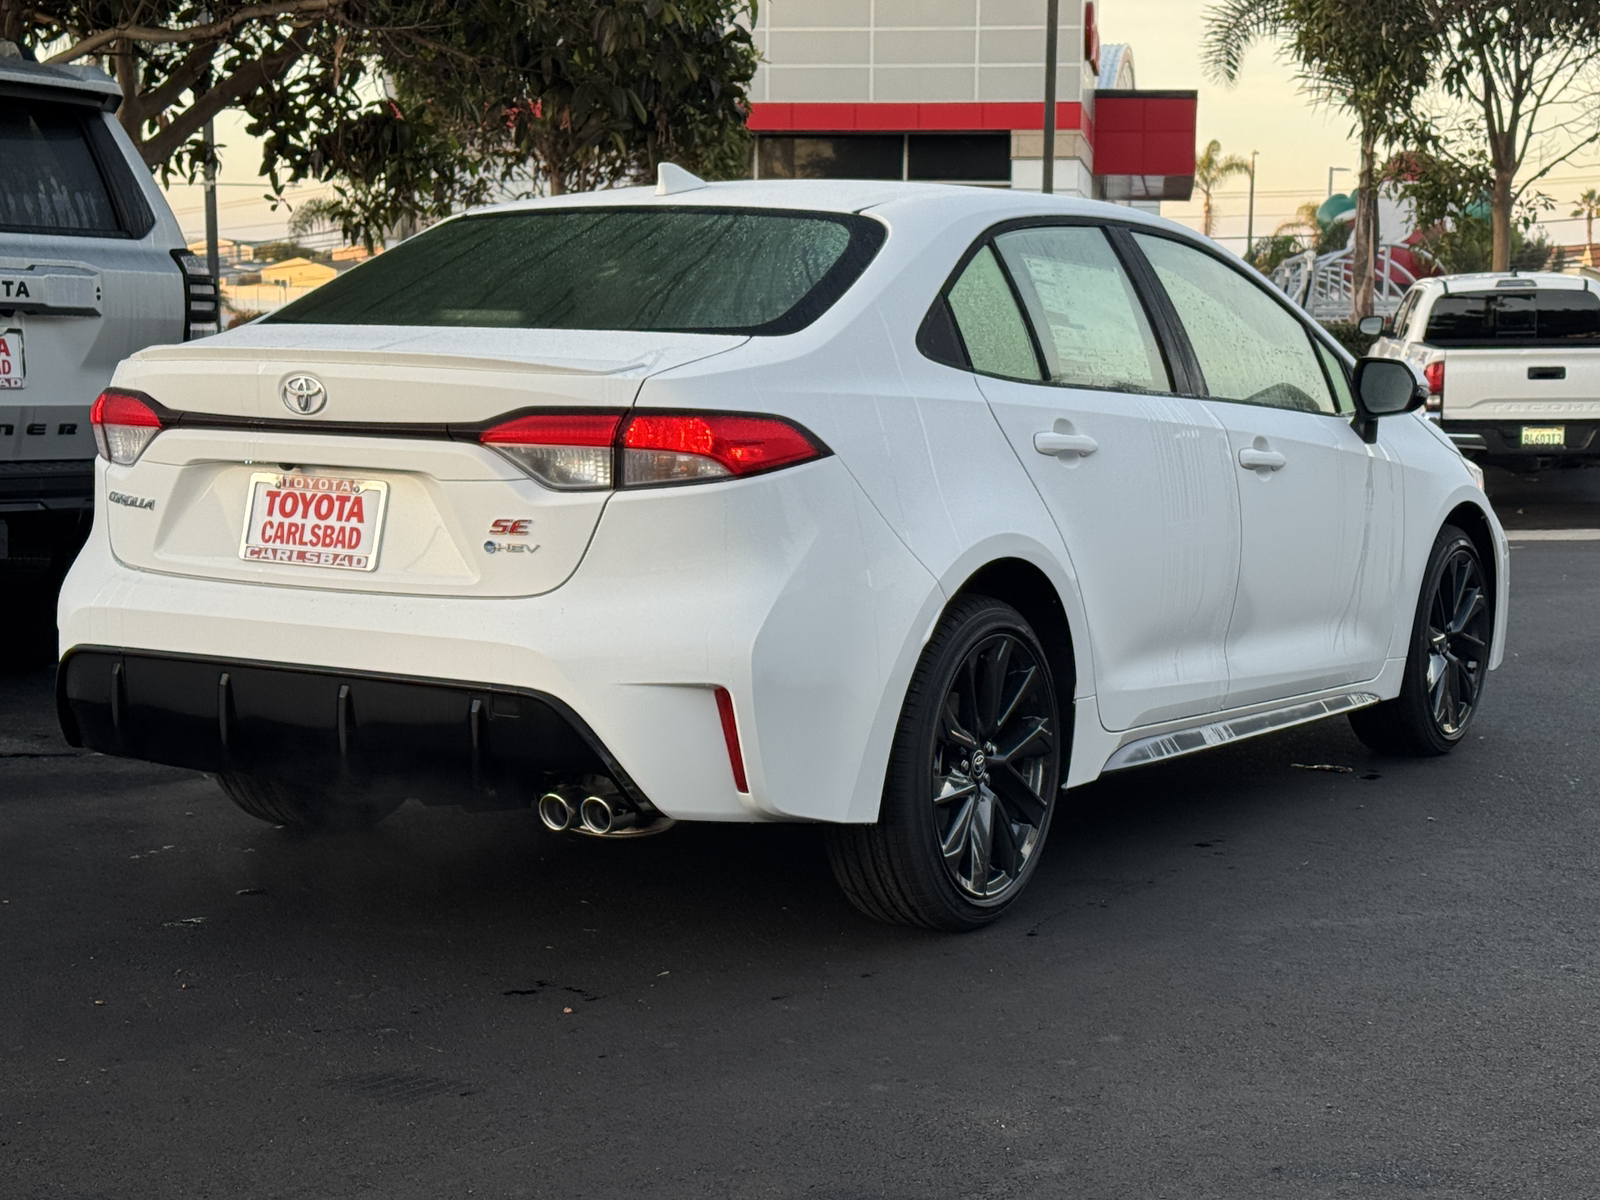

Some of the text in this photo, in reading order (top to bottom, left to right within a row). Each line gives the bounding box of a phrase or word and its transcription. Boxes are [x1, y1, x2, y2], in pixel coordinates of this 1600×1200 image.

[284, 477, 351, 491] TOYOTA
[108, 490, 156, 511] COROLLA
[266, 490, 365, 523] TOYOTA
[261, 520, 362, 550] CARLSBAD
[488, 518, 533, 535] SE
[245, 546, 367, 568] CARLSBAD
